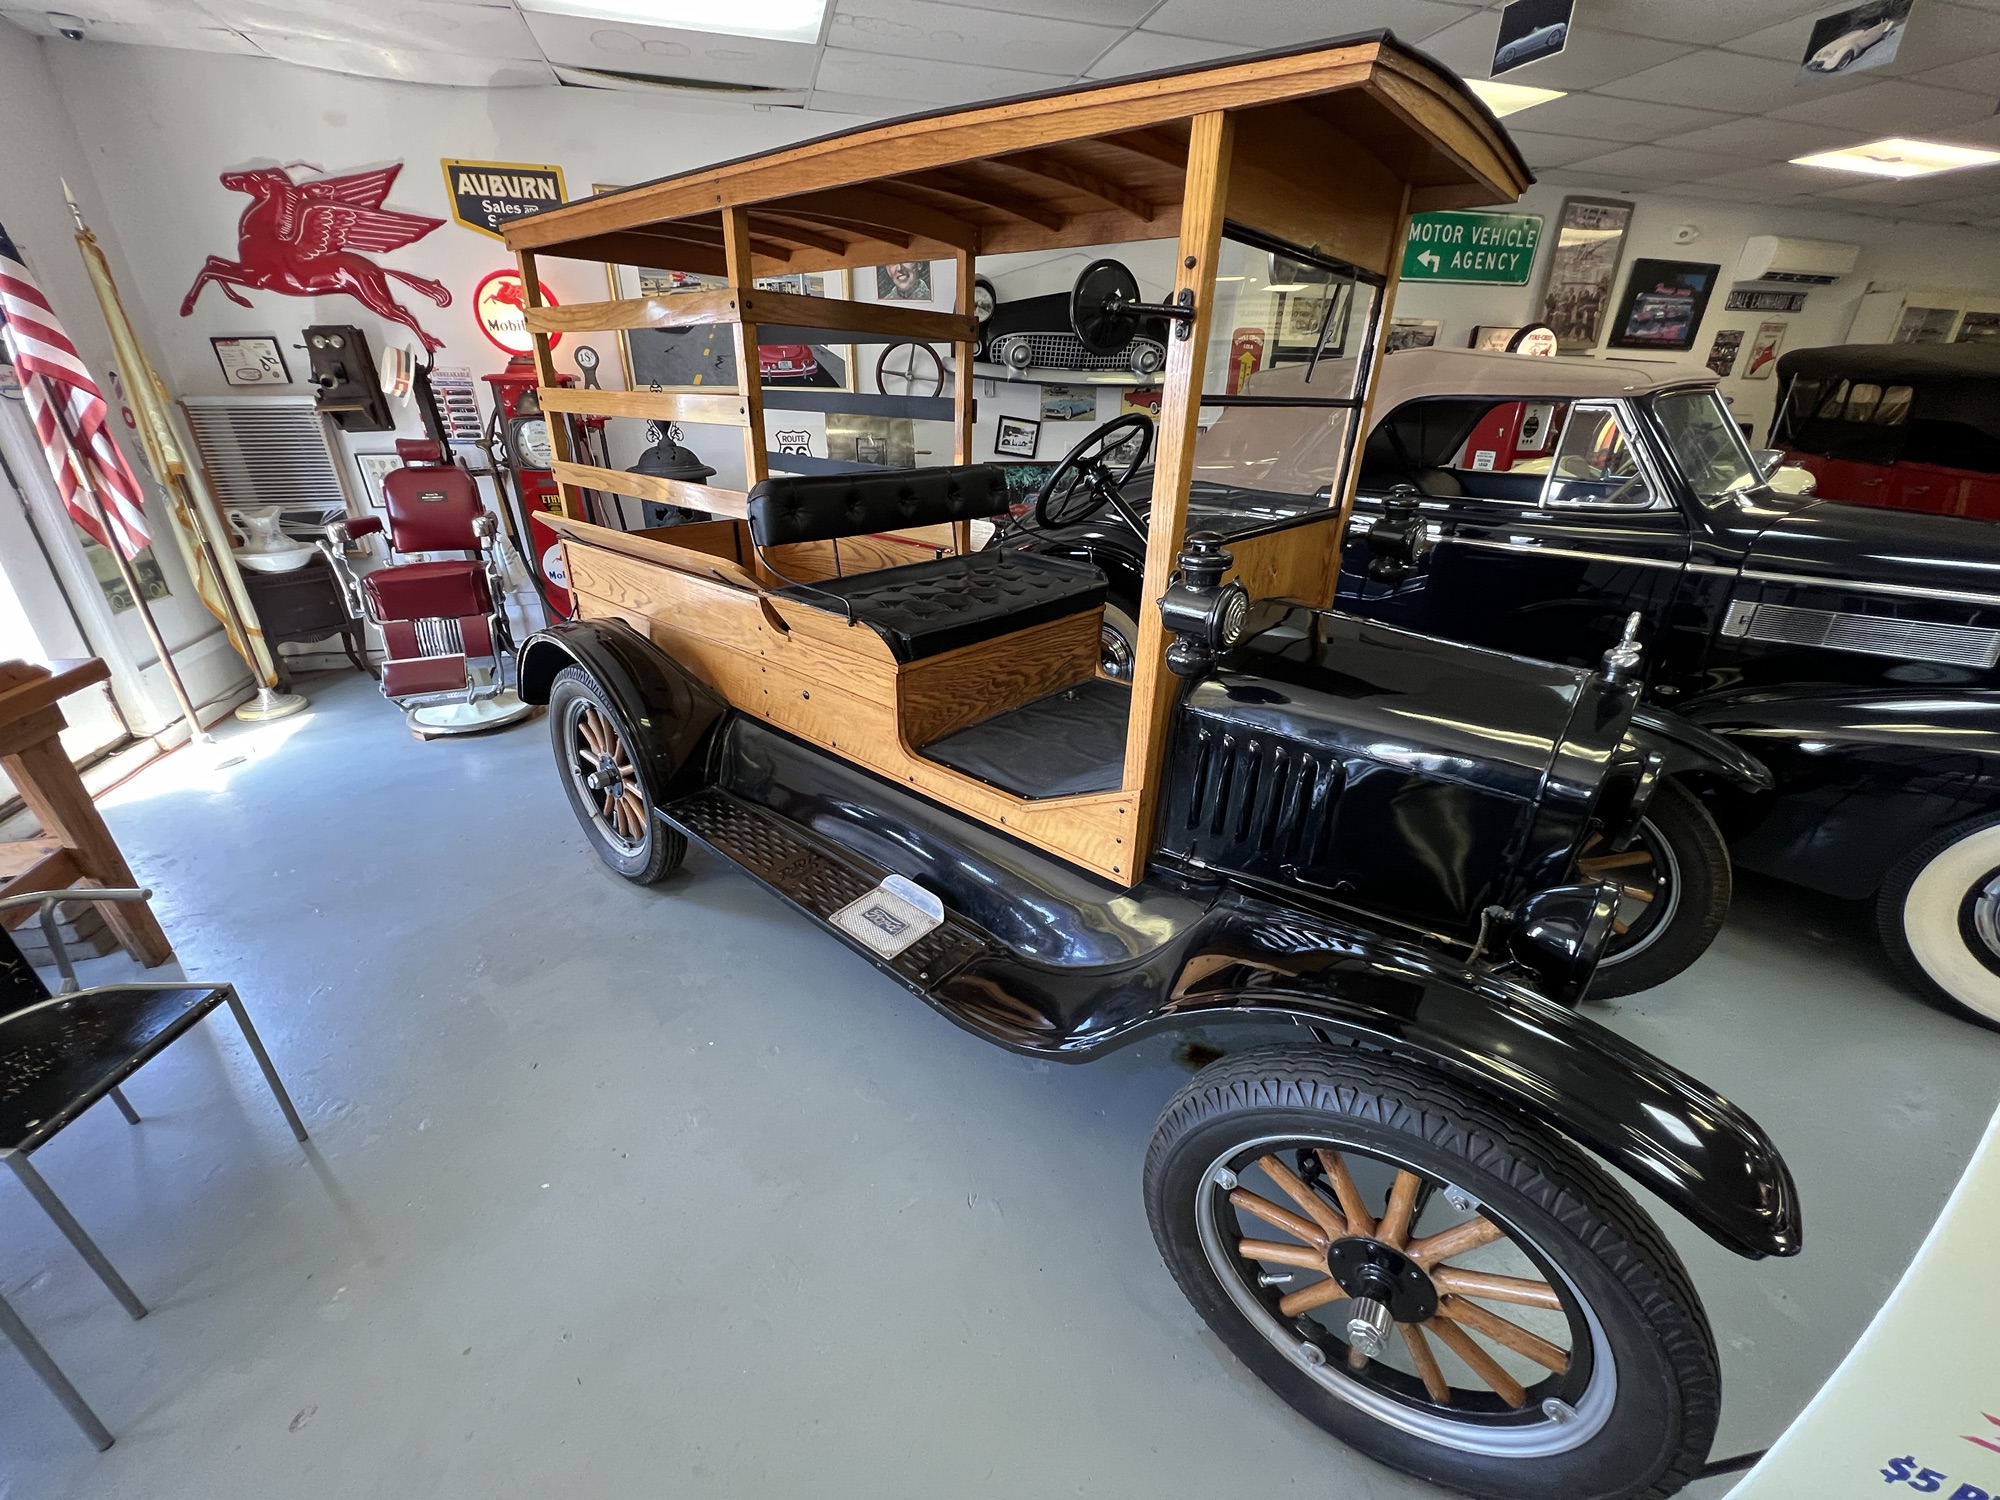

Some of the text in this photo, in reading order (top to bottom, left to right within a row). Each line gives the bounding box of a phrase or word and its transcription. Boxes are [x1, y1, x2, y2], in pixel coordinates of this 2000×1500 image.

[458, 172, 557, 200] AUBURN
[481, 199, 522, 214] Sales
[1408, 222, 1537, 248] MOTOR VEHICLE
[1450, 250, 1520, 271] AGENCY
[864, 908, 902, 932] Ford
[1879, 1455, 1948, 1493] $5
